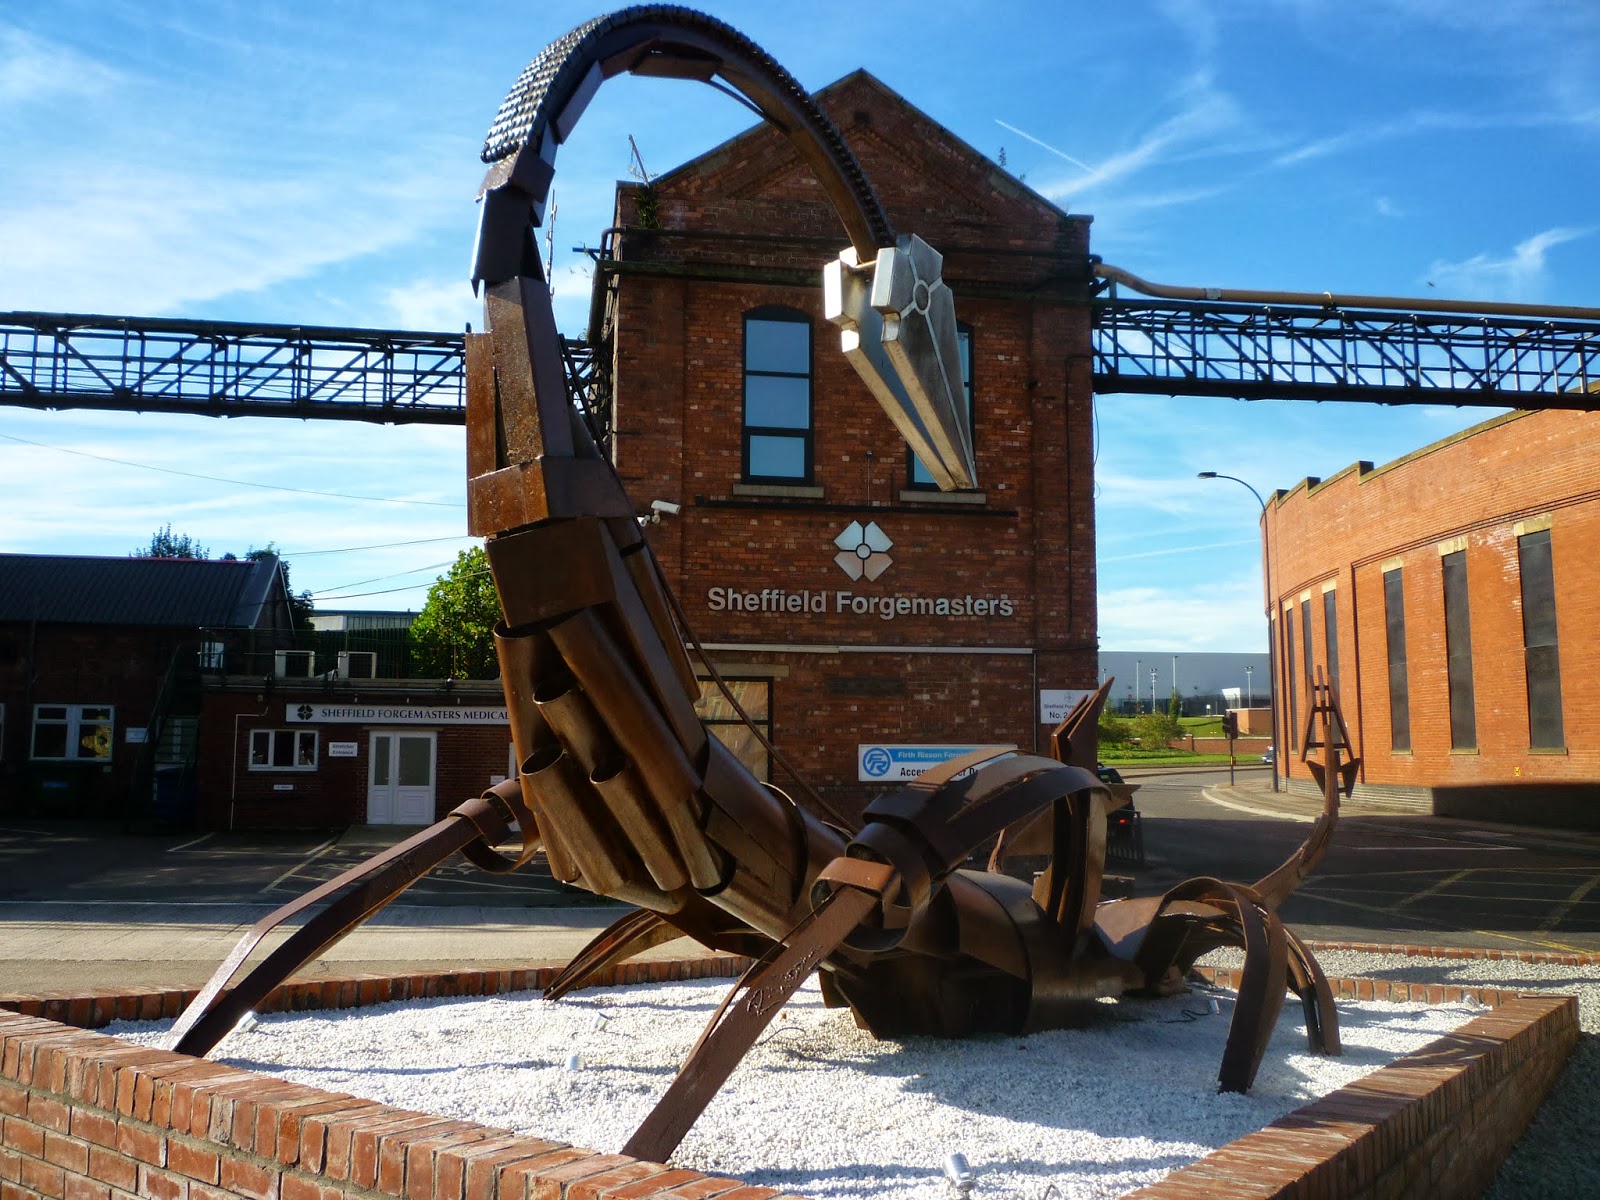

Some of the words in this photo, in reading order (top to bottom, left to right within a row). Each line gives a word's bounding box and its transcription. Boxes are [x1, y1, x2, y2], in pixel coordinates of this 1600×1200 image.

[707, 587, 827, 612] Sheffield
[836, 590, 1014, 620] Forgemasters
[321, 708, 375, 718] SHEFFIELD
[378, 709, 460, 719] FORGEMASTERS
[463, 710, 510, 720] MEDICAL
[1049, 711, 1062, 719] No.
[917, 751, 942, 759] Rixson
